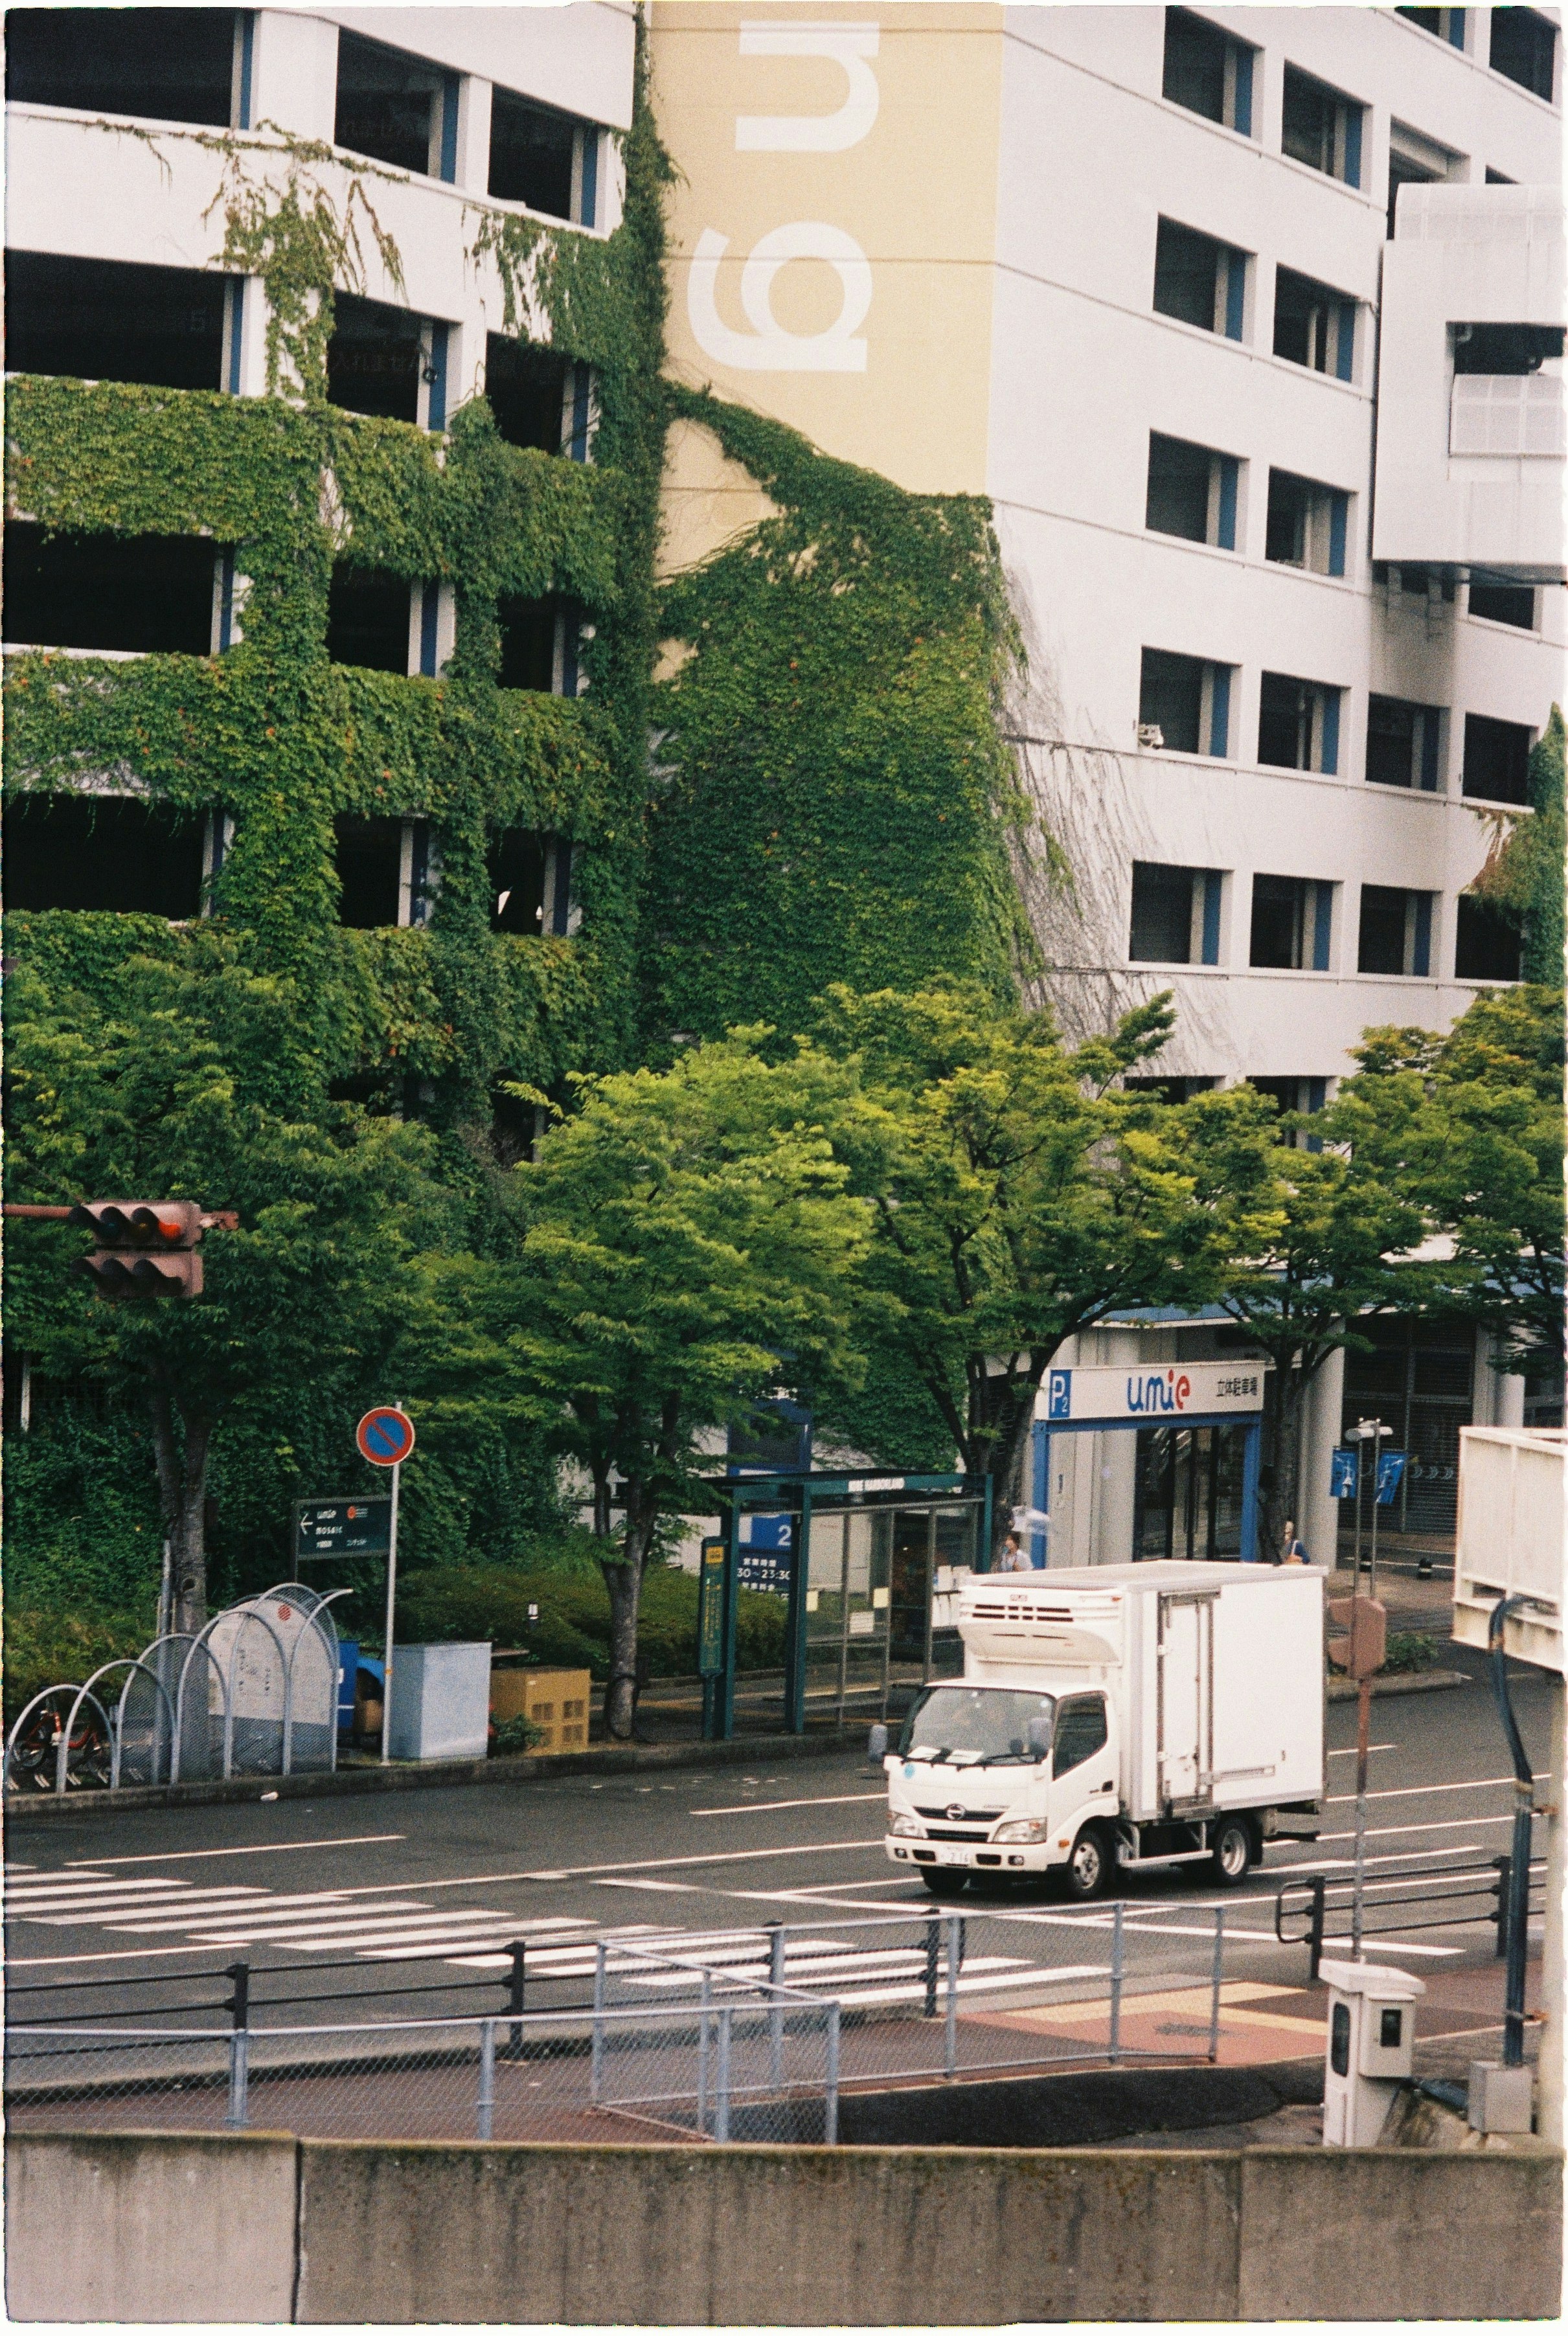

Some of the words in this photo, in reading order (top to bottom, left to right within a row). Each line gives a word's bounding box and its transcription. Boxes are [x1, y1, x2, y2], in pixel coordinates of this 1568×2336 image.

[1127, 1369, 1190, 1412] umie
[1216, 1378, 1258, 1397] 立体駐車場
